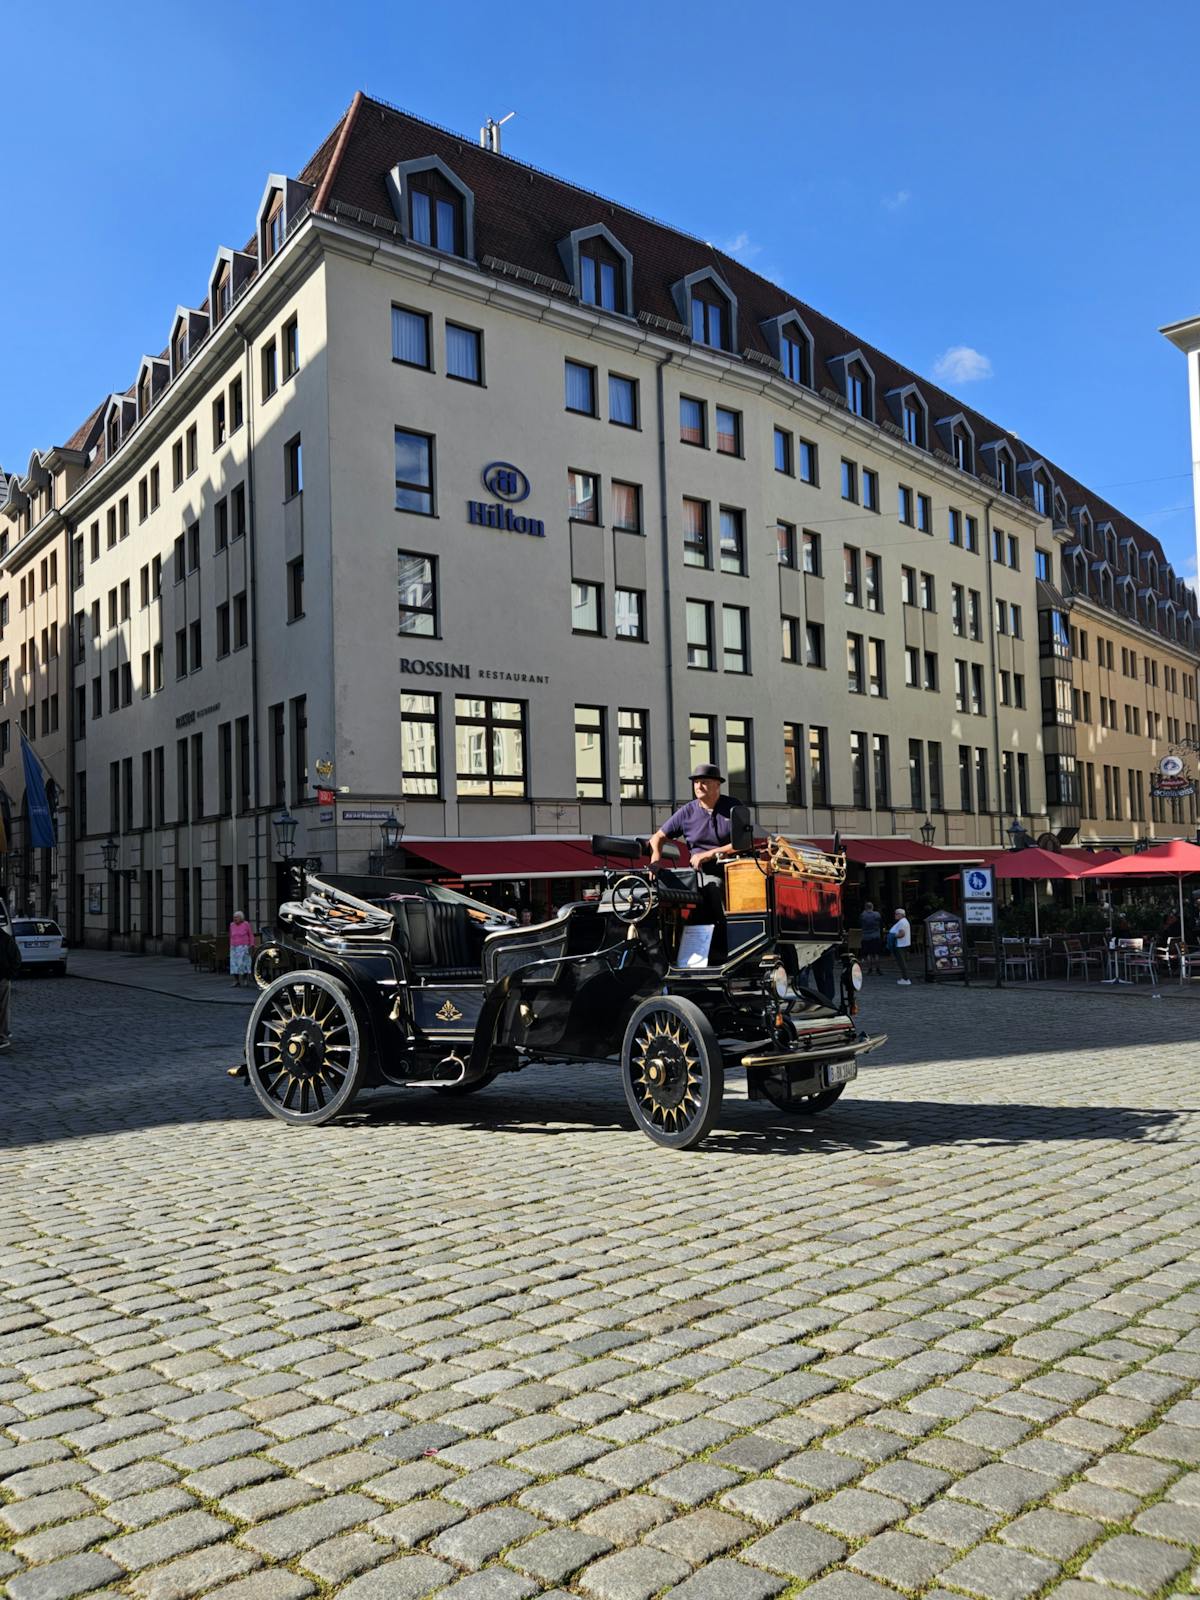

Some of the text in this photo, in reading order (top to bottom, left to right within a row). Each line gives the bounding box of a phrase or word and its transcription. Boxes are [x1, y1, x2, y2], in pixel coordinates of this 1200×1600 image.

[467, 500, 546, 537] Hilton
[400, 658, 550, 684] ROSSINI RESTAURANT
